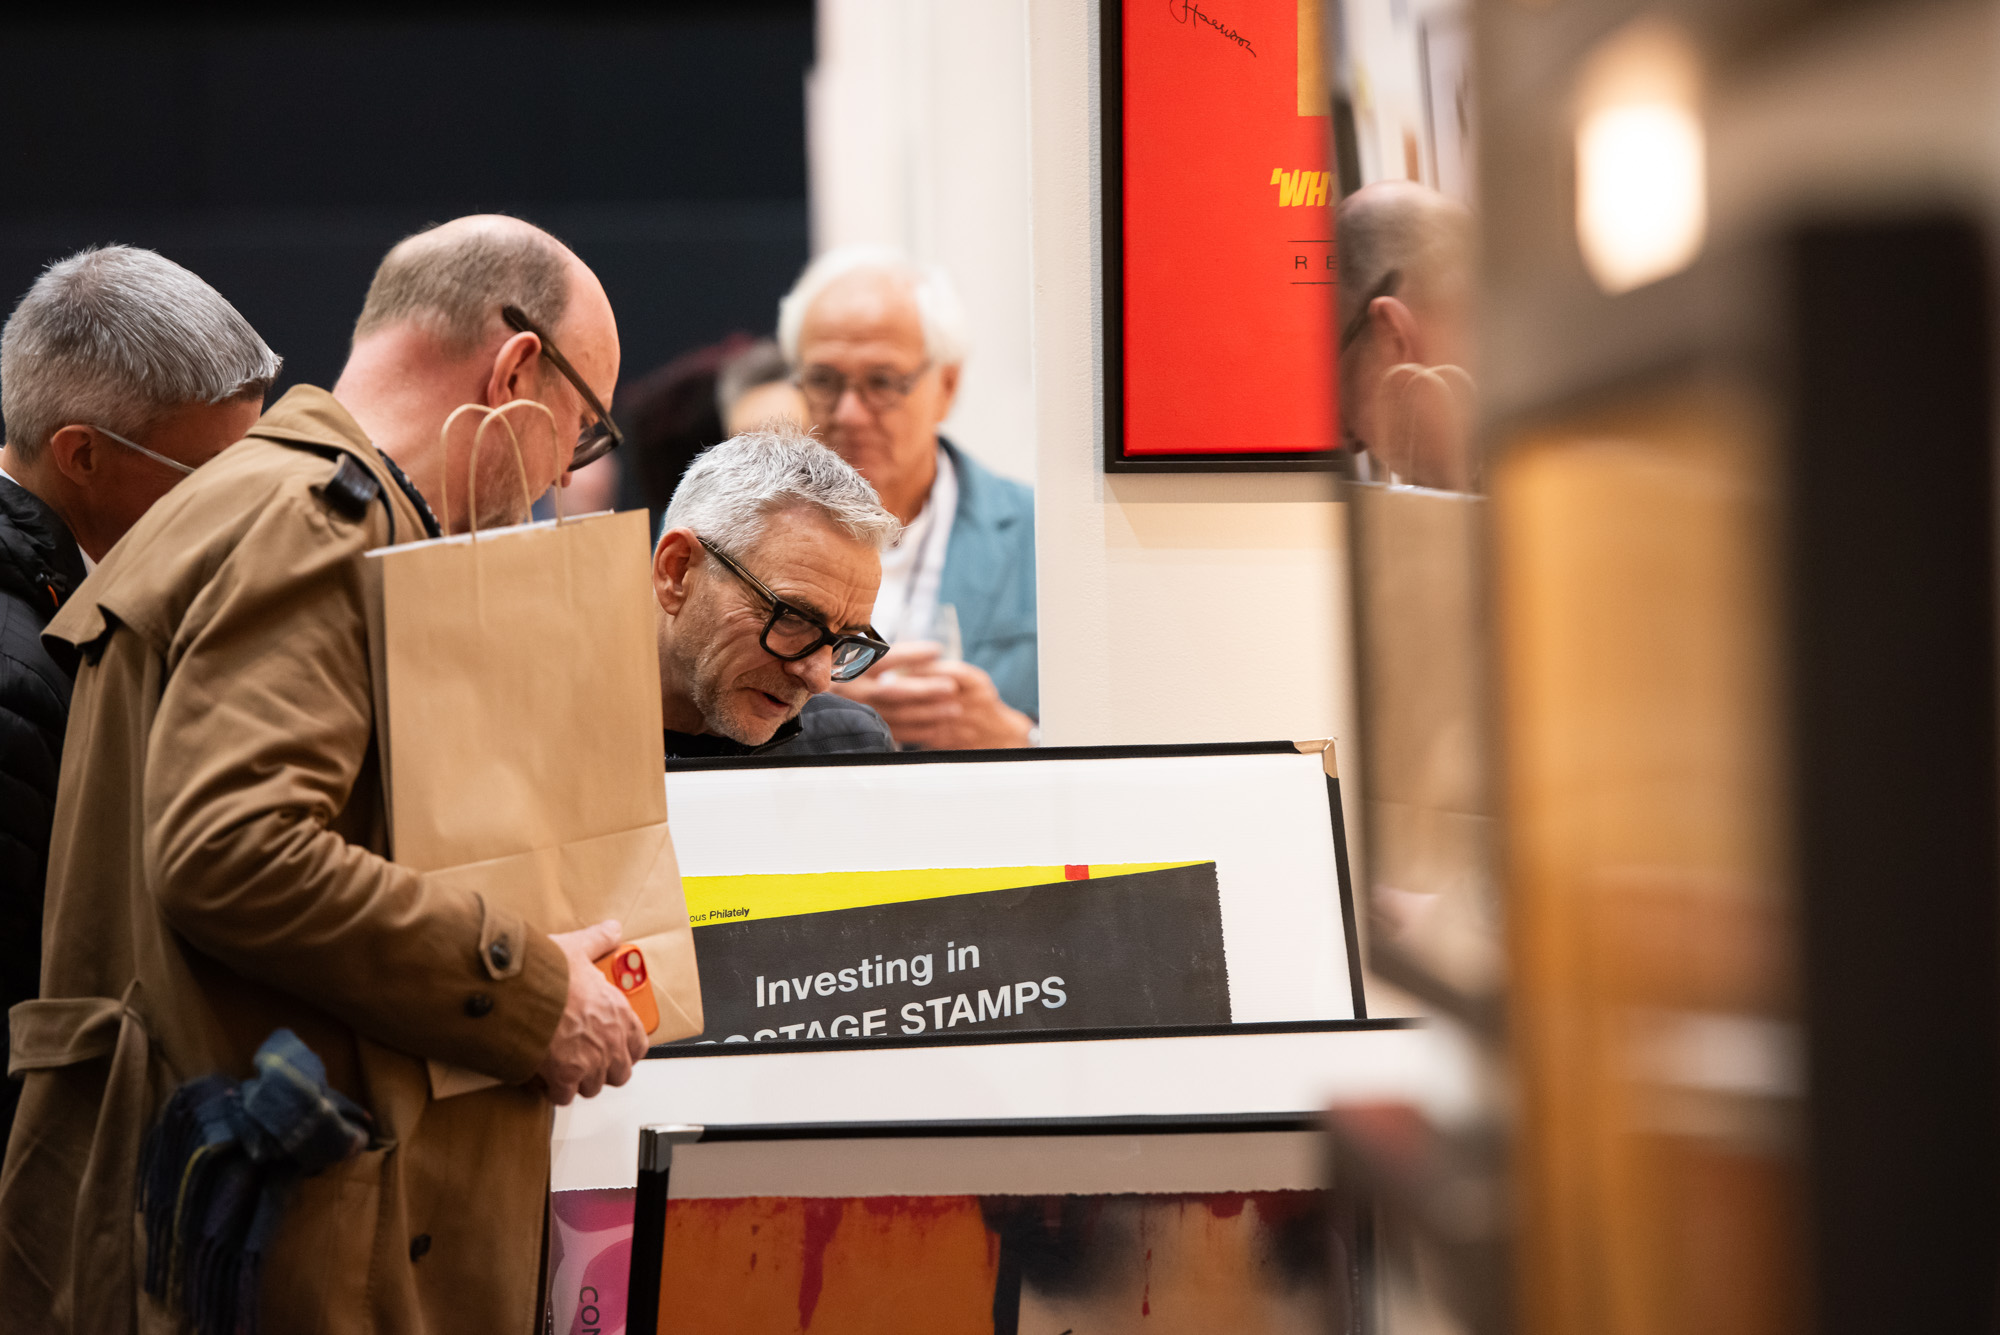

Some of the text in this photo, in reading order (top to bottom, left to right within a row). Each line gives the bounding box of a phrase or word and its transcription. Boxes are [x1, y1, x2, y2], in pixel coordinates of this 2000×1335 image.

[709, 906, 750, 919] Philately
[756, 941, 981, 1008] Investing in
[694, 975, 1067, 1045] TAGE STAMPS
